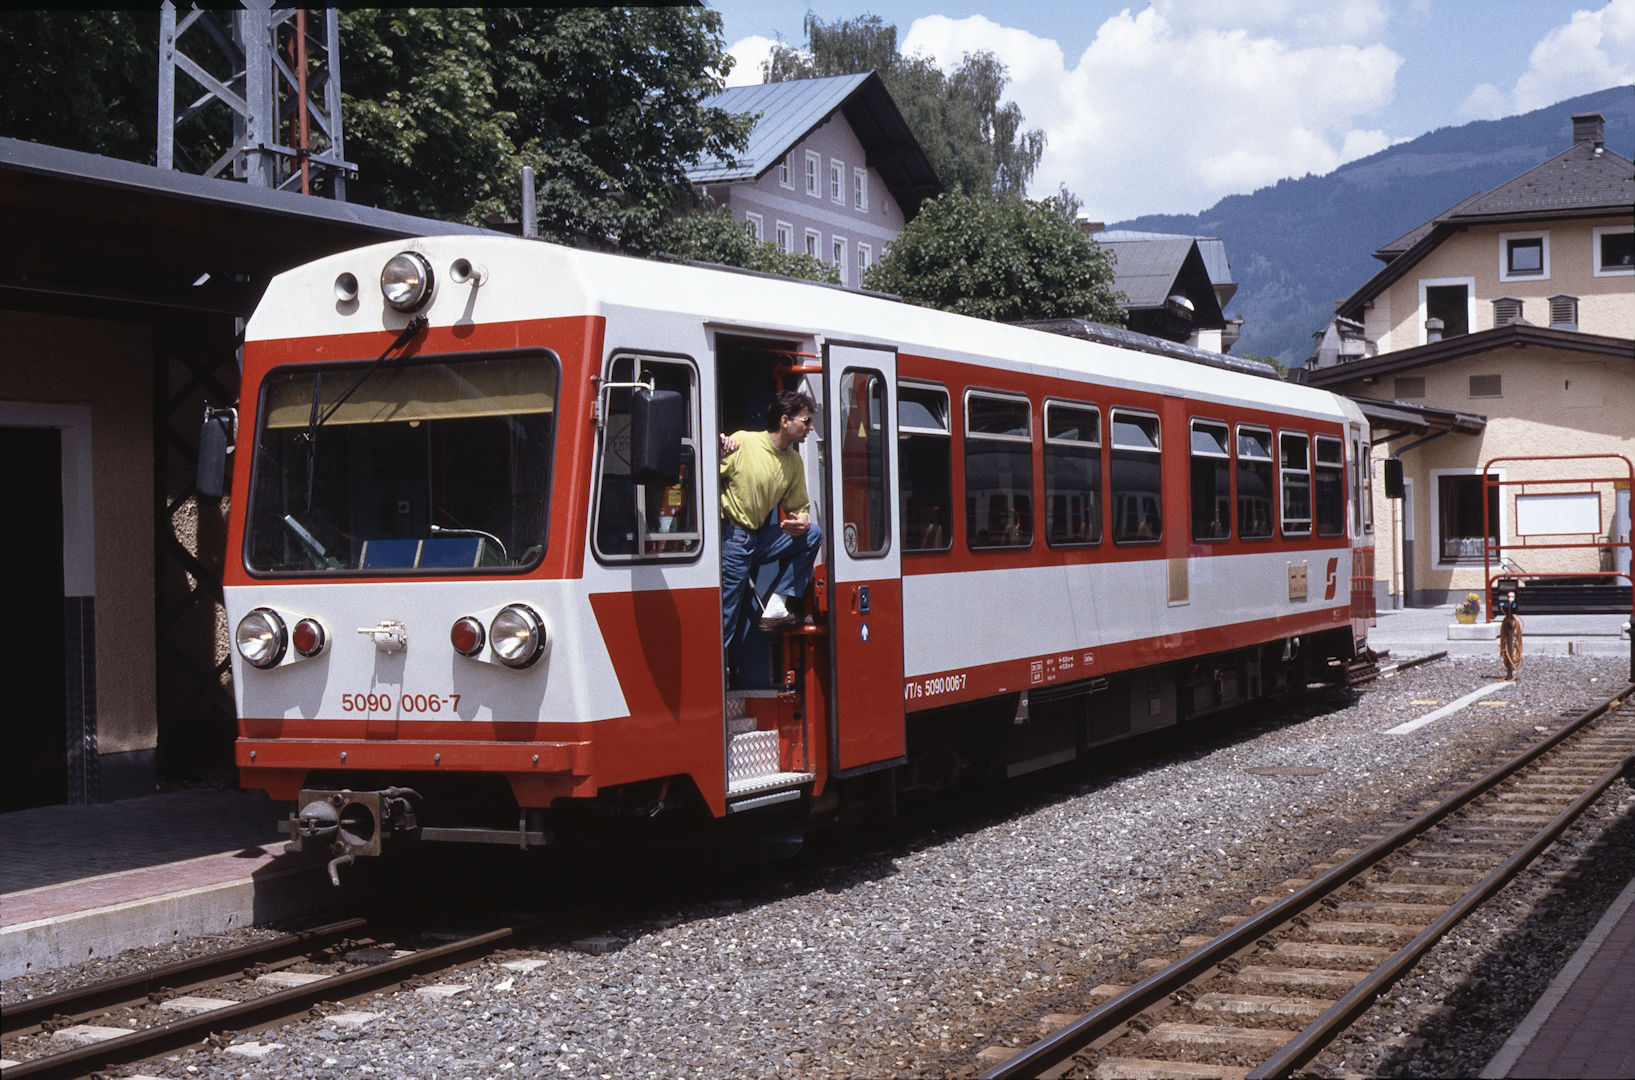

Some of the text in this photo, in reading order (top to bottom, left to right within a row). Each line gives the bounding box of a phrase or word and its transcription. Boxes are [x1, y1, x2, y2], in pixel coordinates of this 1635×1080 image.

[925, 678, 944, 696] 5090
[945, 674, 966, 692] 006-7
[342, 693, 461, 712] 5090 006-7
